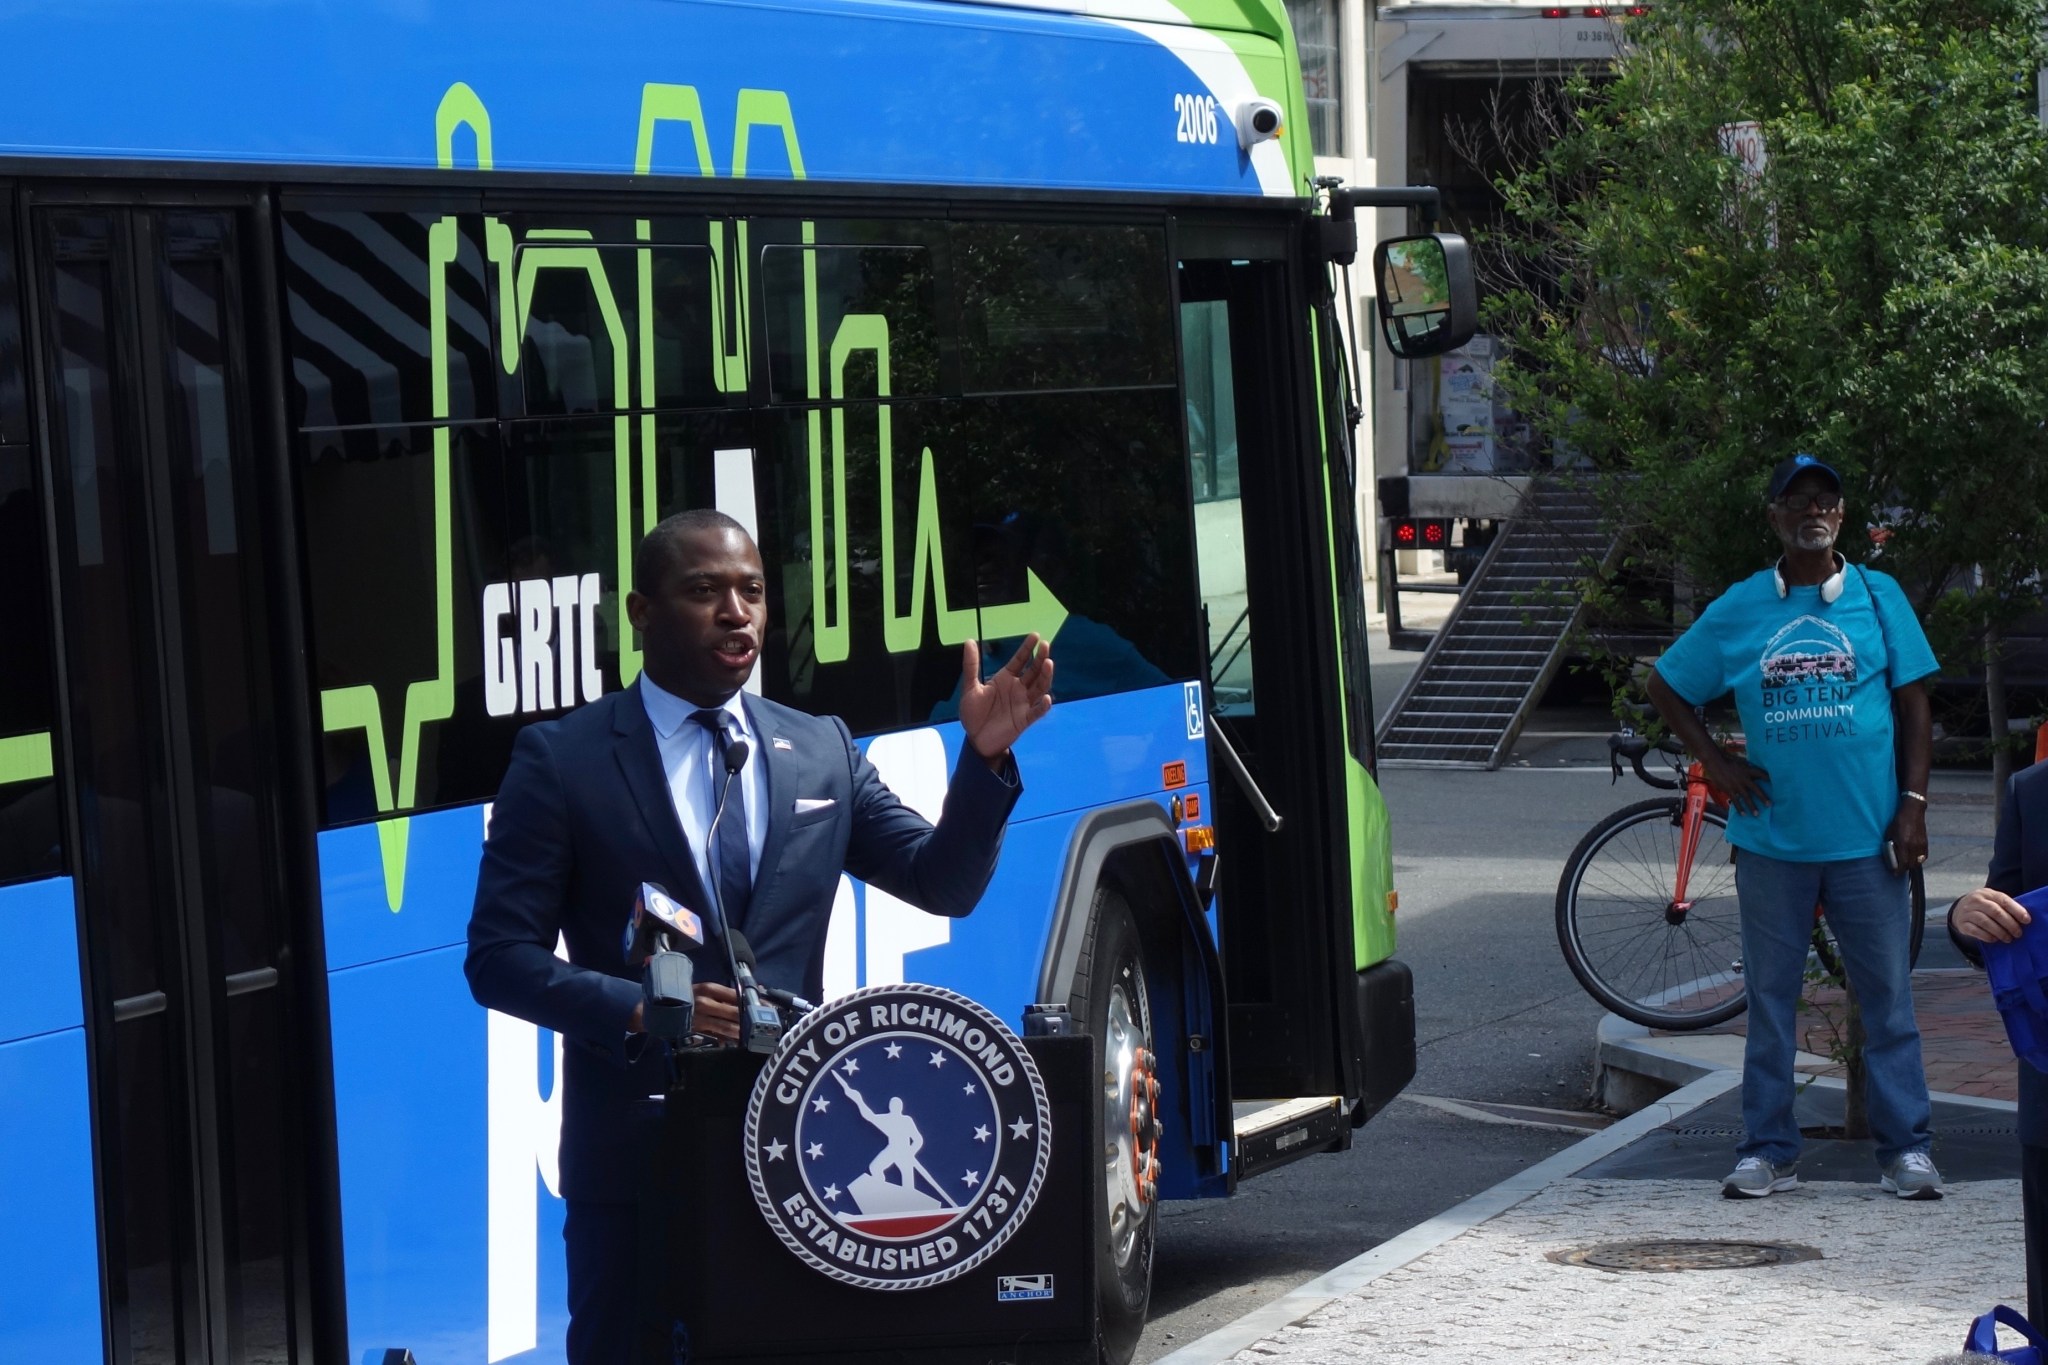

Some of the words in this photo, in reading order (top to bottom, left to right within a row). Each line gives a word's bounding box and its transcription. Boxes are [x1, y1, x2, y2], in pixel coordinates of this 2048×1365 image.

[1174, 93, 1217, 144] 2006
[1735, 137, 1756, 164] NO
[483, 572, 602, 717] GRTC
[1762, 689, 1798, 708] BIG
[1804, 685, 1857, 702] TENT
[1764, 704, 1854, 723] COMMUNITY
[1765, 720, 1858, 744] FESTIVAL
[776, 1037, 824, 1105] CITY
[823, 1012, 864, 1046] OF
[870, 1002, 1015, 1087] RICHMOND
[782, 1192, 958, 1270] ESTABLISHED
[962, 1175, 1016, 1240] 1737
[1001, 1290, 1050, 1299] ANCHOR
